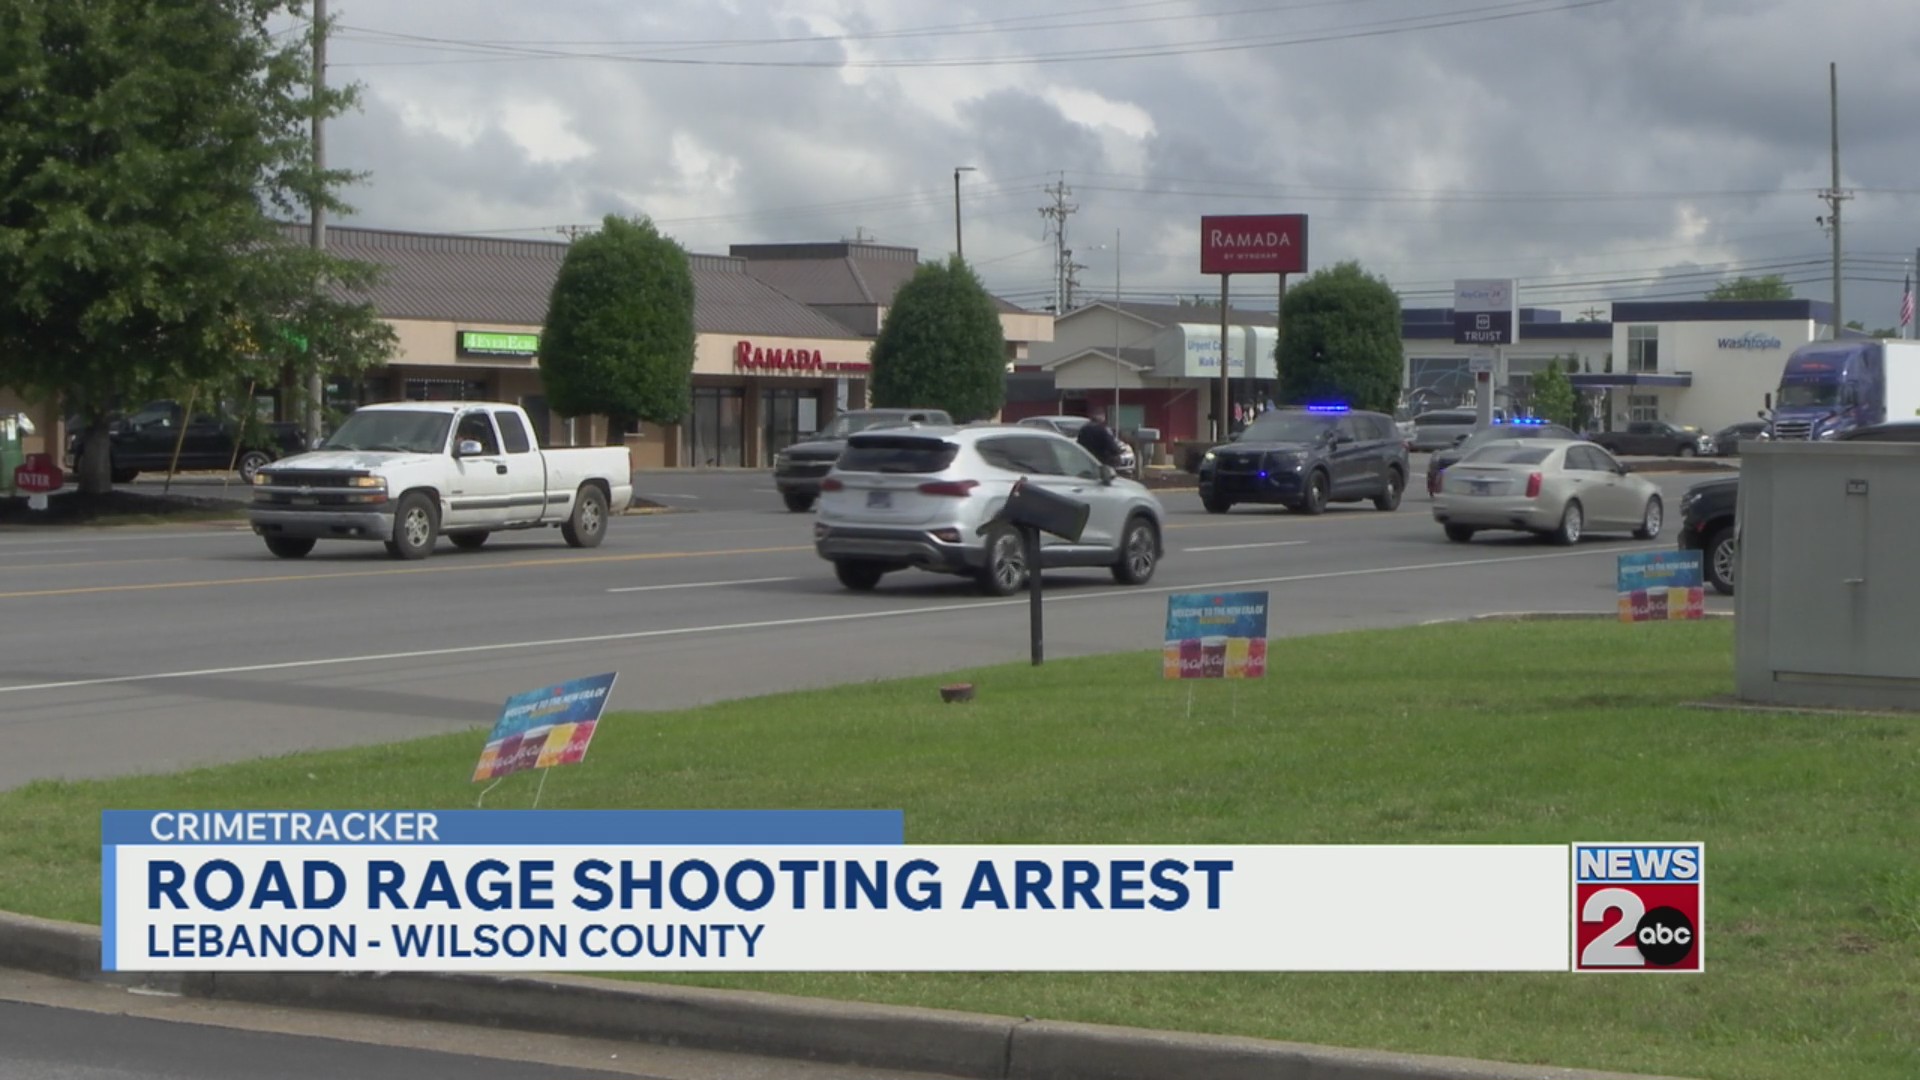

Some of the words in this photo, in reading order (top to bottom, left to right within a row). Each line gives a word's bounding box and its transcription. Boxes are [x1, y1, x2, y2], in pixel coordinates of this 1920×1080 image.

[1211, 229, 1291, 249] RAMADA
[1464, 331, 1502, 342] TRUIST
[1188, 340, 1211, 352] Urgent
[737, 341, 823, 370] RAMADA
[18, 473, 50, 488] ENTER
